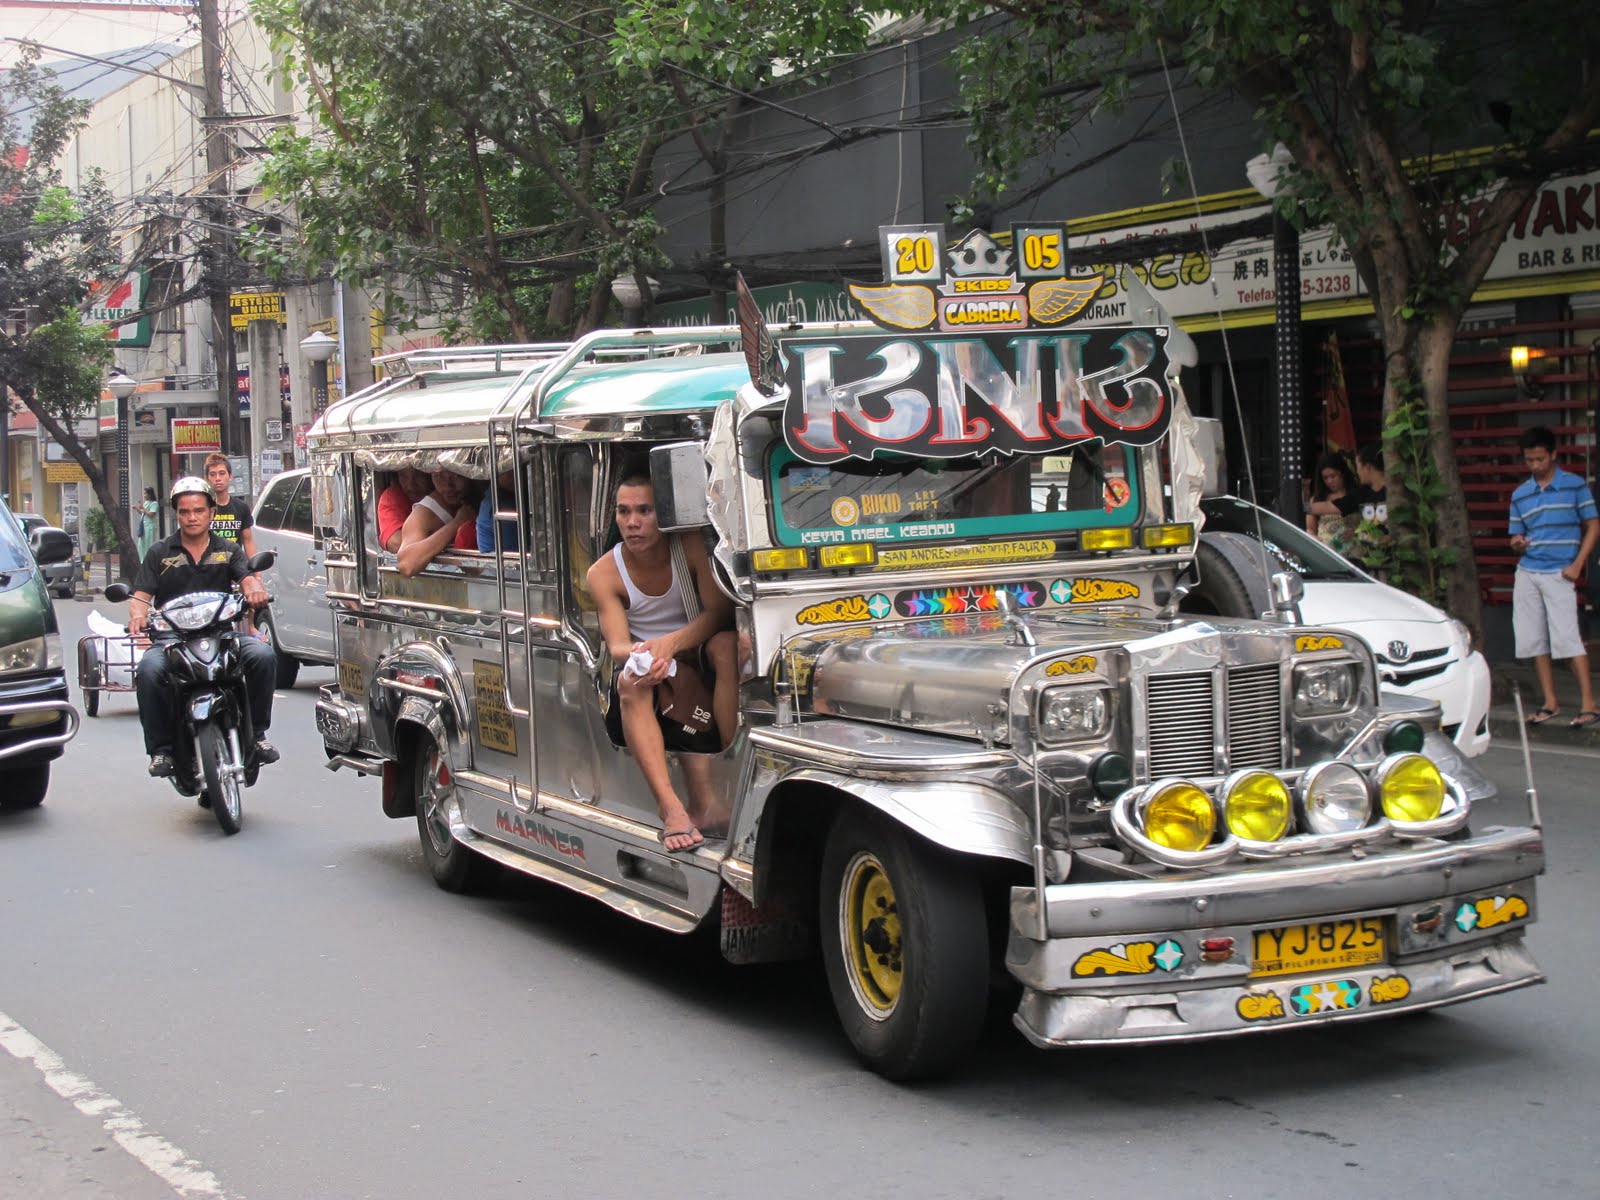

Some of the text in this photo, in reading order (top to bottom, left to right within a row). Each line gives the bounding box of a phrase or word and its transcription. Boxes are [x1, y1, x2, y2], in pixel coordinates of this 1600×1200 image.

[895, 233, 1062, 275] 20 05
[1518, 251, 1556, 269] BAR
[1562, 248, 1574, 265] &
[953, 279, 1012, 293] 3KIDS
[242, 304, 279, 314] UNION
[945, 301, 1022, 325] CABRERA
[175, 425, 194, 444] MONEY
[860, 492, 902, 516] BUKID
[915, 490, 936, 500] LRT
[908, 500, 939, 512] TAFT
[801, 530, 845, 544] KEVIN
[884, 550, 908, 564] SAN
[1013, 540, 1048, 552] FAURA
[694, 705, 711, 720] be
[496, 808, 586, 862] MARINER
